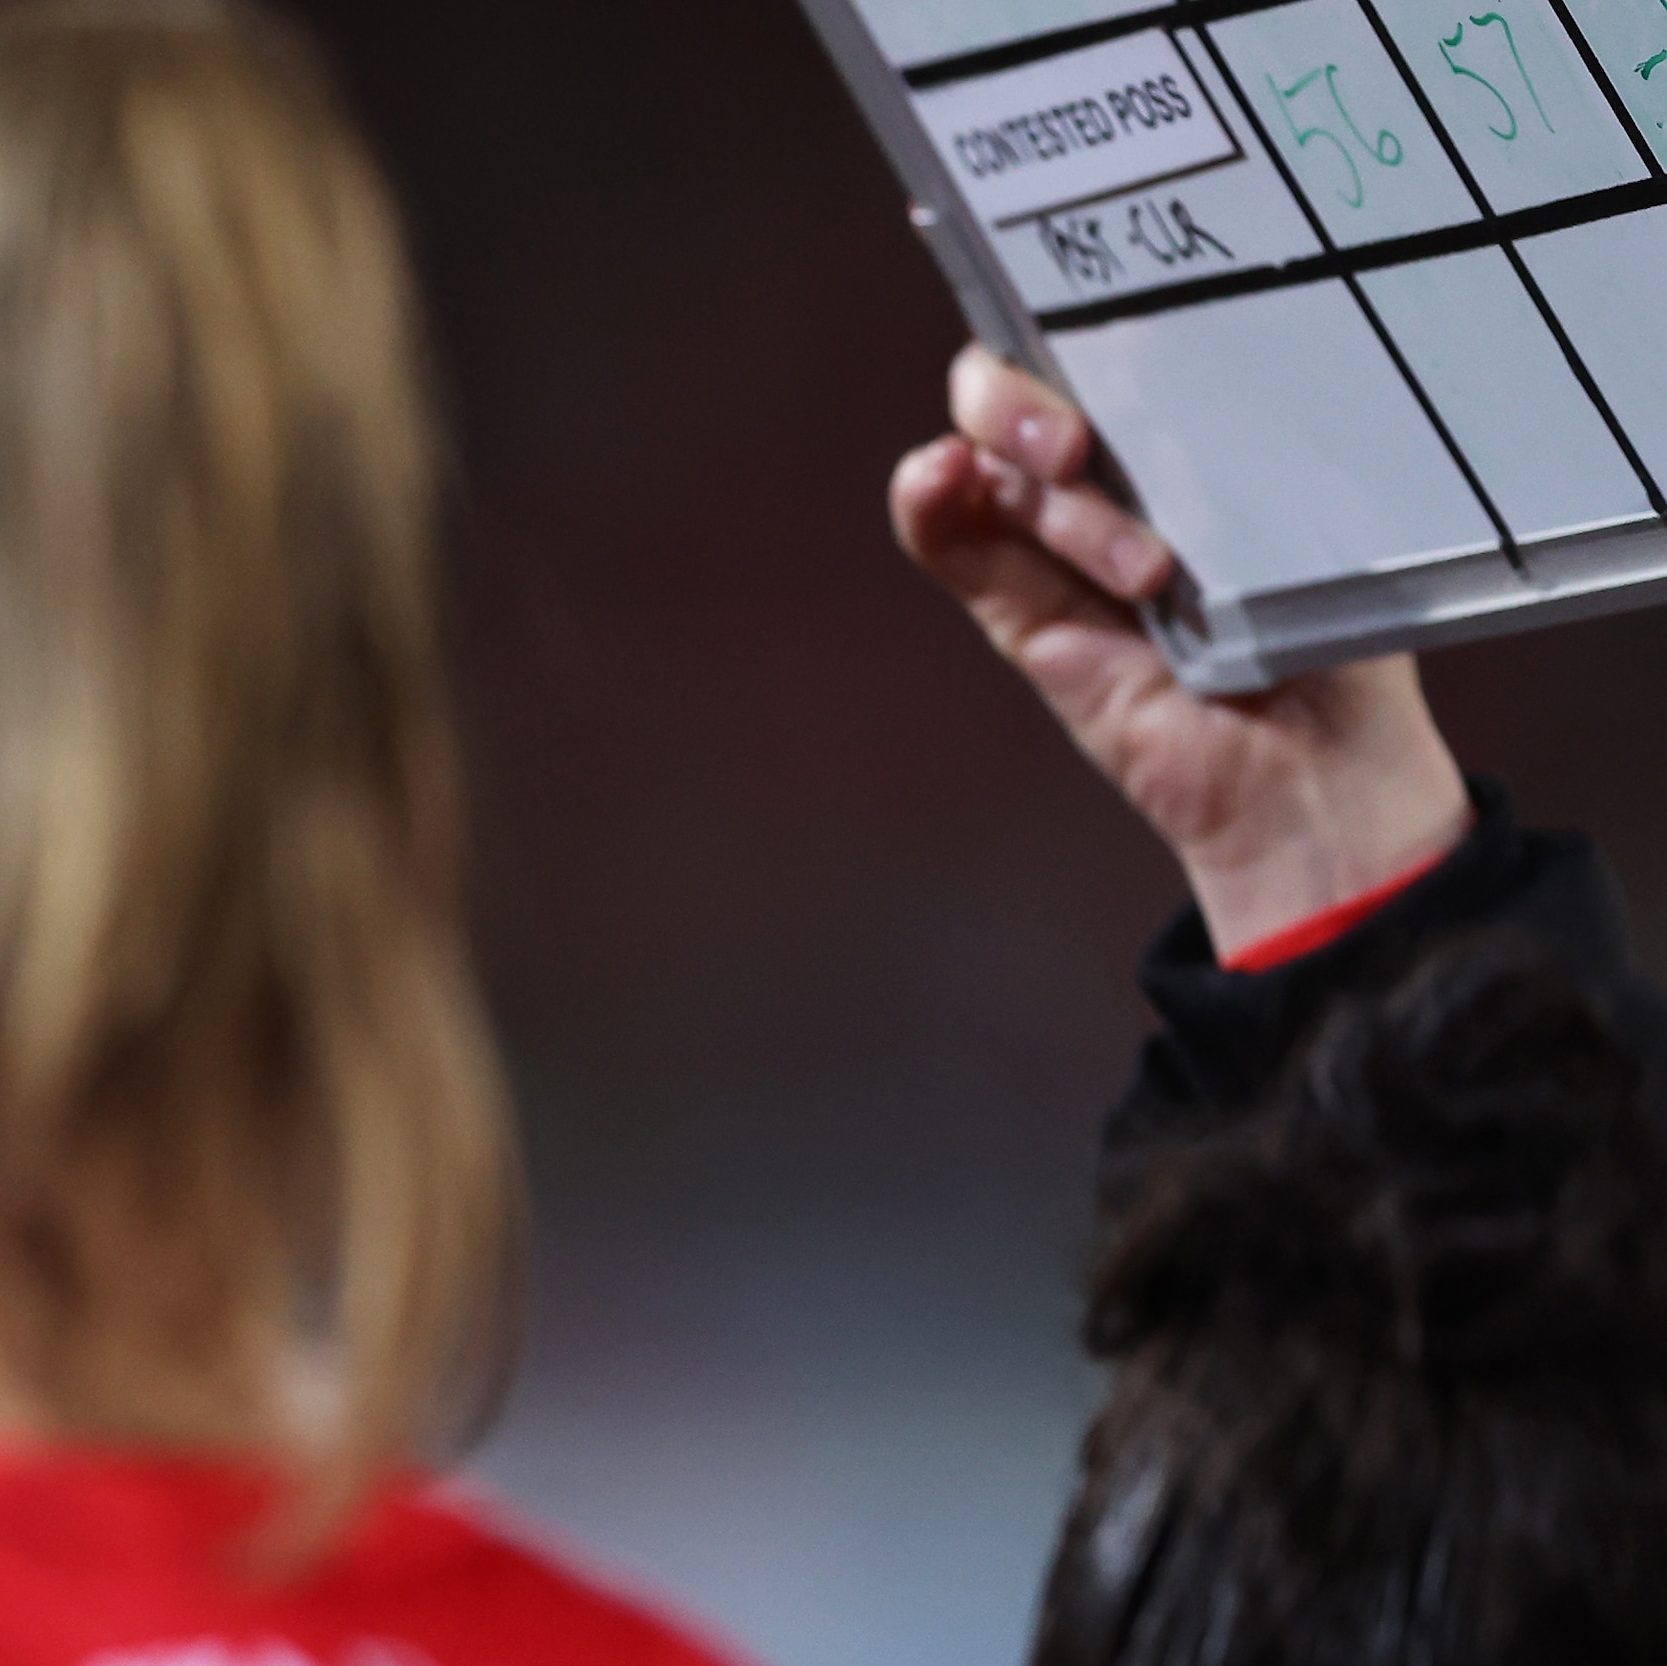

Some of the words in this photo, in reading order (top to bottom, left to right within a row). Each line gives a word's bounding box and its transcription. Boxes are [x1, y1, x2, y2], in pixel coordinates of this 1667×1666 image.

[953, 96, 1115, 178] CONTESTED
[1104, 72, 1194, 138] POSS
[1264, 62, 1404, 209] 56
[1437, 11, 1556, 141] 57
